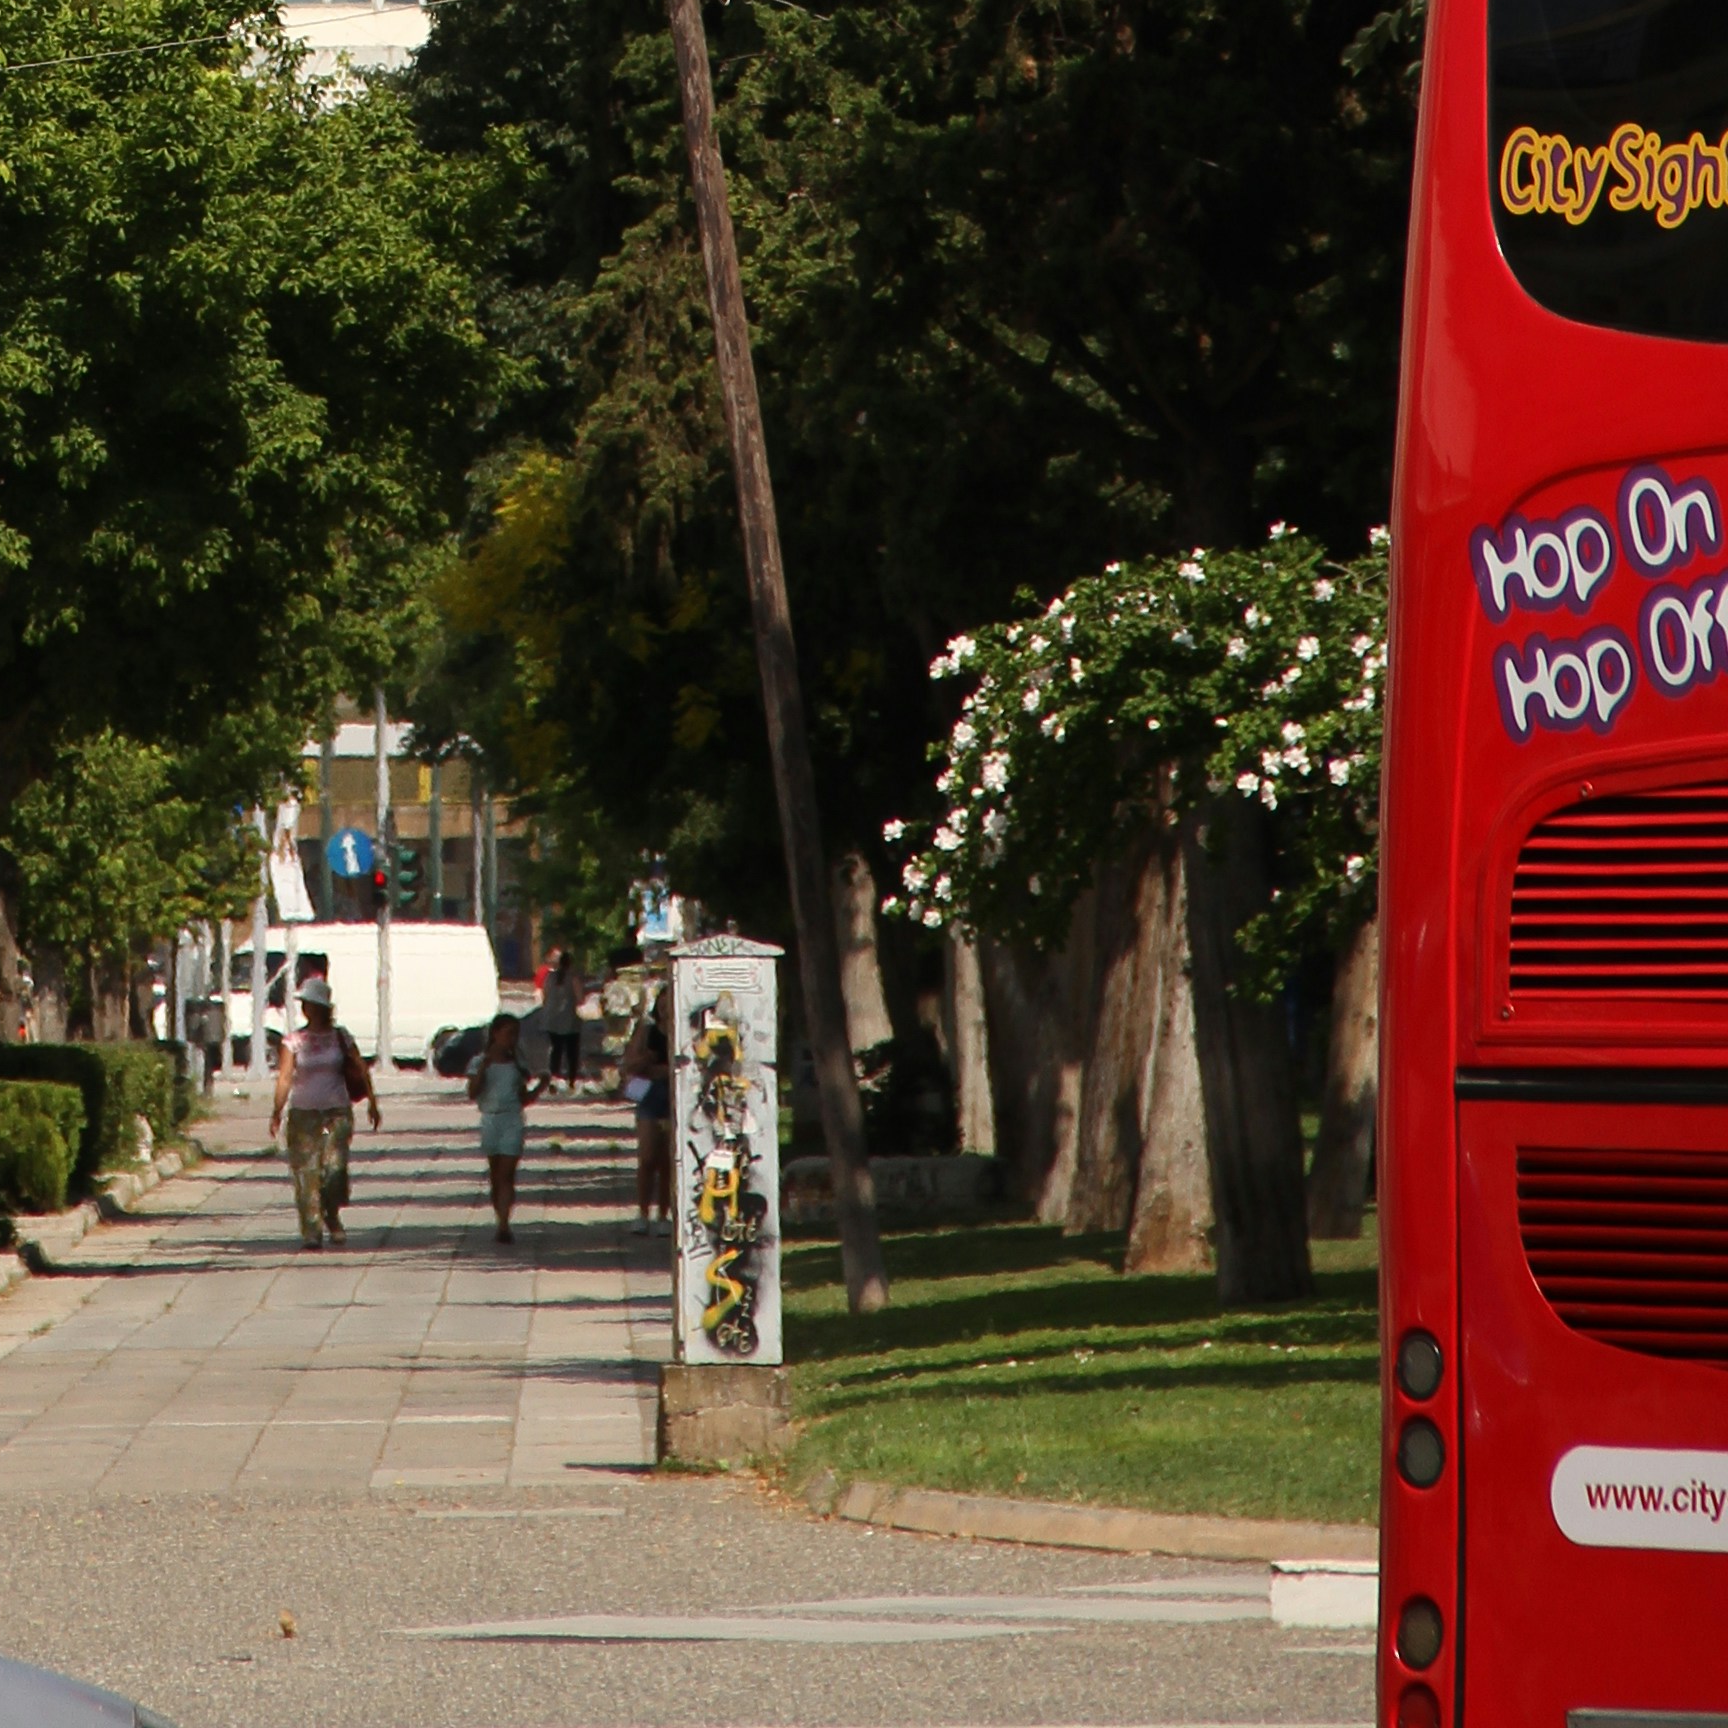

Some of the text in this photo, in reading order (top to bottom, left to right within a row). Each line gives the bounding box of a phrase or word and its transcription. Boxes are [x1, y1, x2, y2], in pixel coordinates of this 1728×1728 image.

[1500, 123, 1728, 229] CitySigh
[1481, 476, 1717, 613] Hop On
[1503, 638, 1633, 733] Hop
